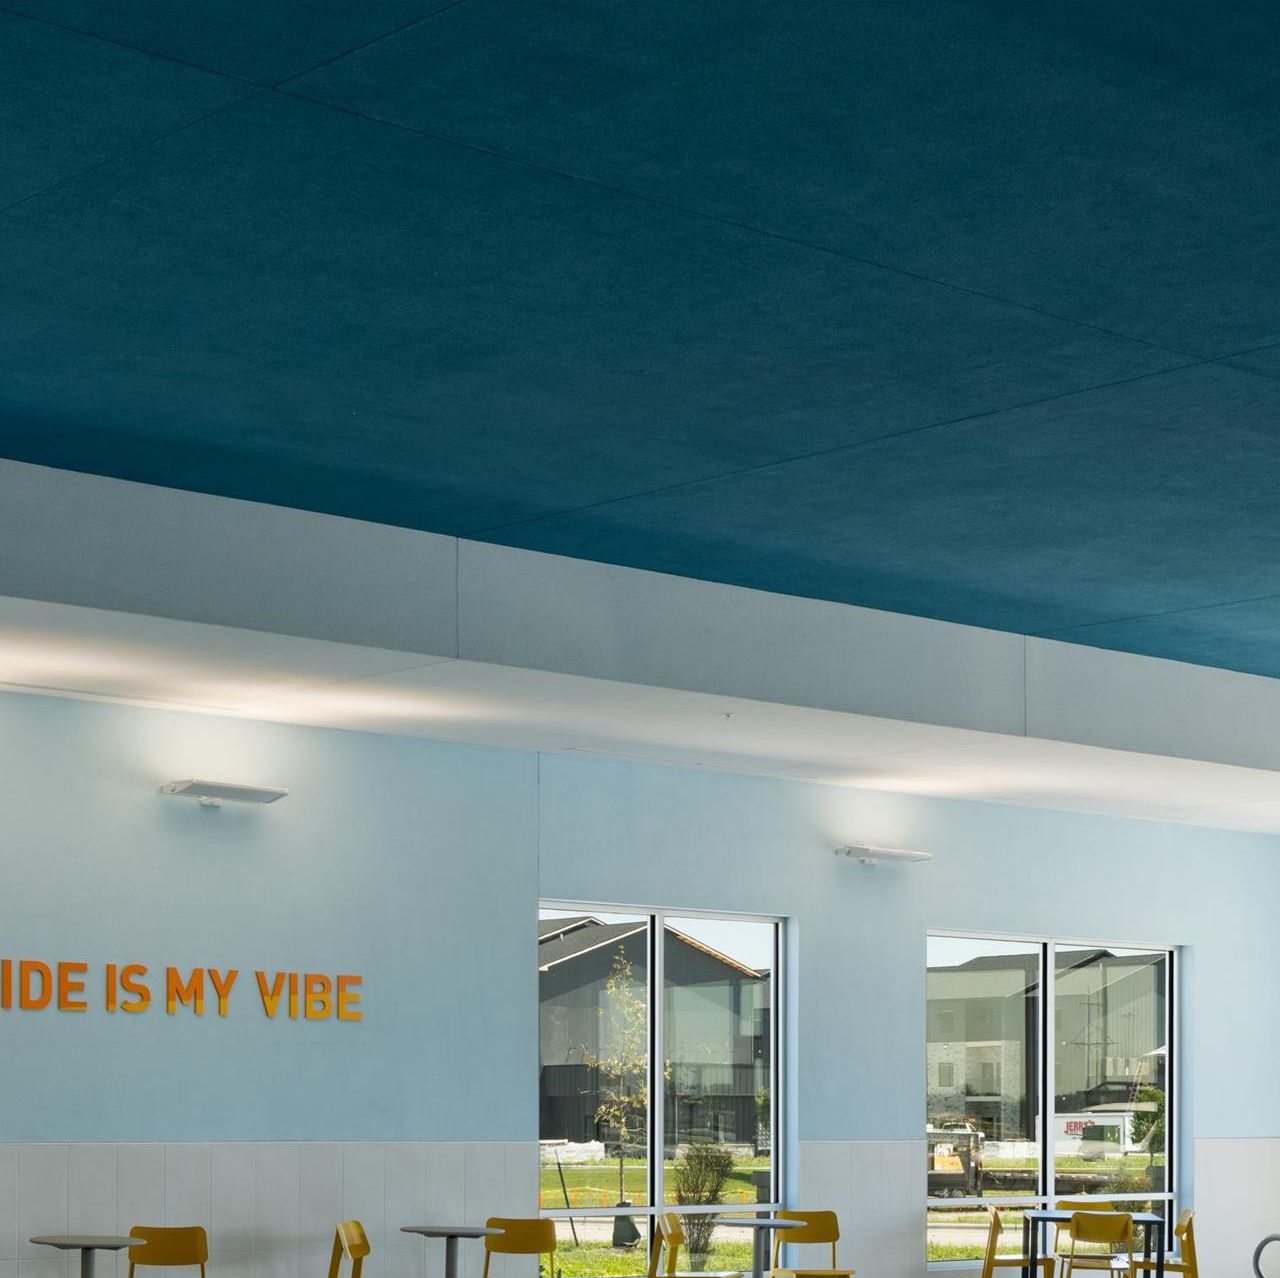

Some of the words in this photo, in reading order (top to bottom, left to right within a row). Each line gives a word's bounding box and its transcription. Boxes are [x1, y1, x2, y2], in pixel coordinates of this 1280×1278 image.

[106, 963, 151, 1013] IS
[166, 966, 239, 1017] MY
[255, 970, 363, 1020] VIBE
